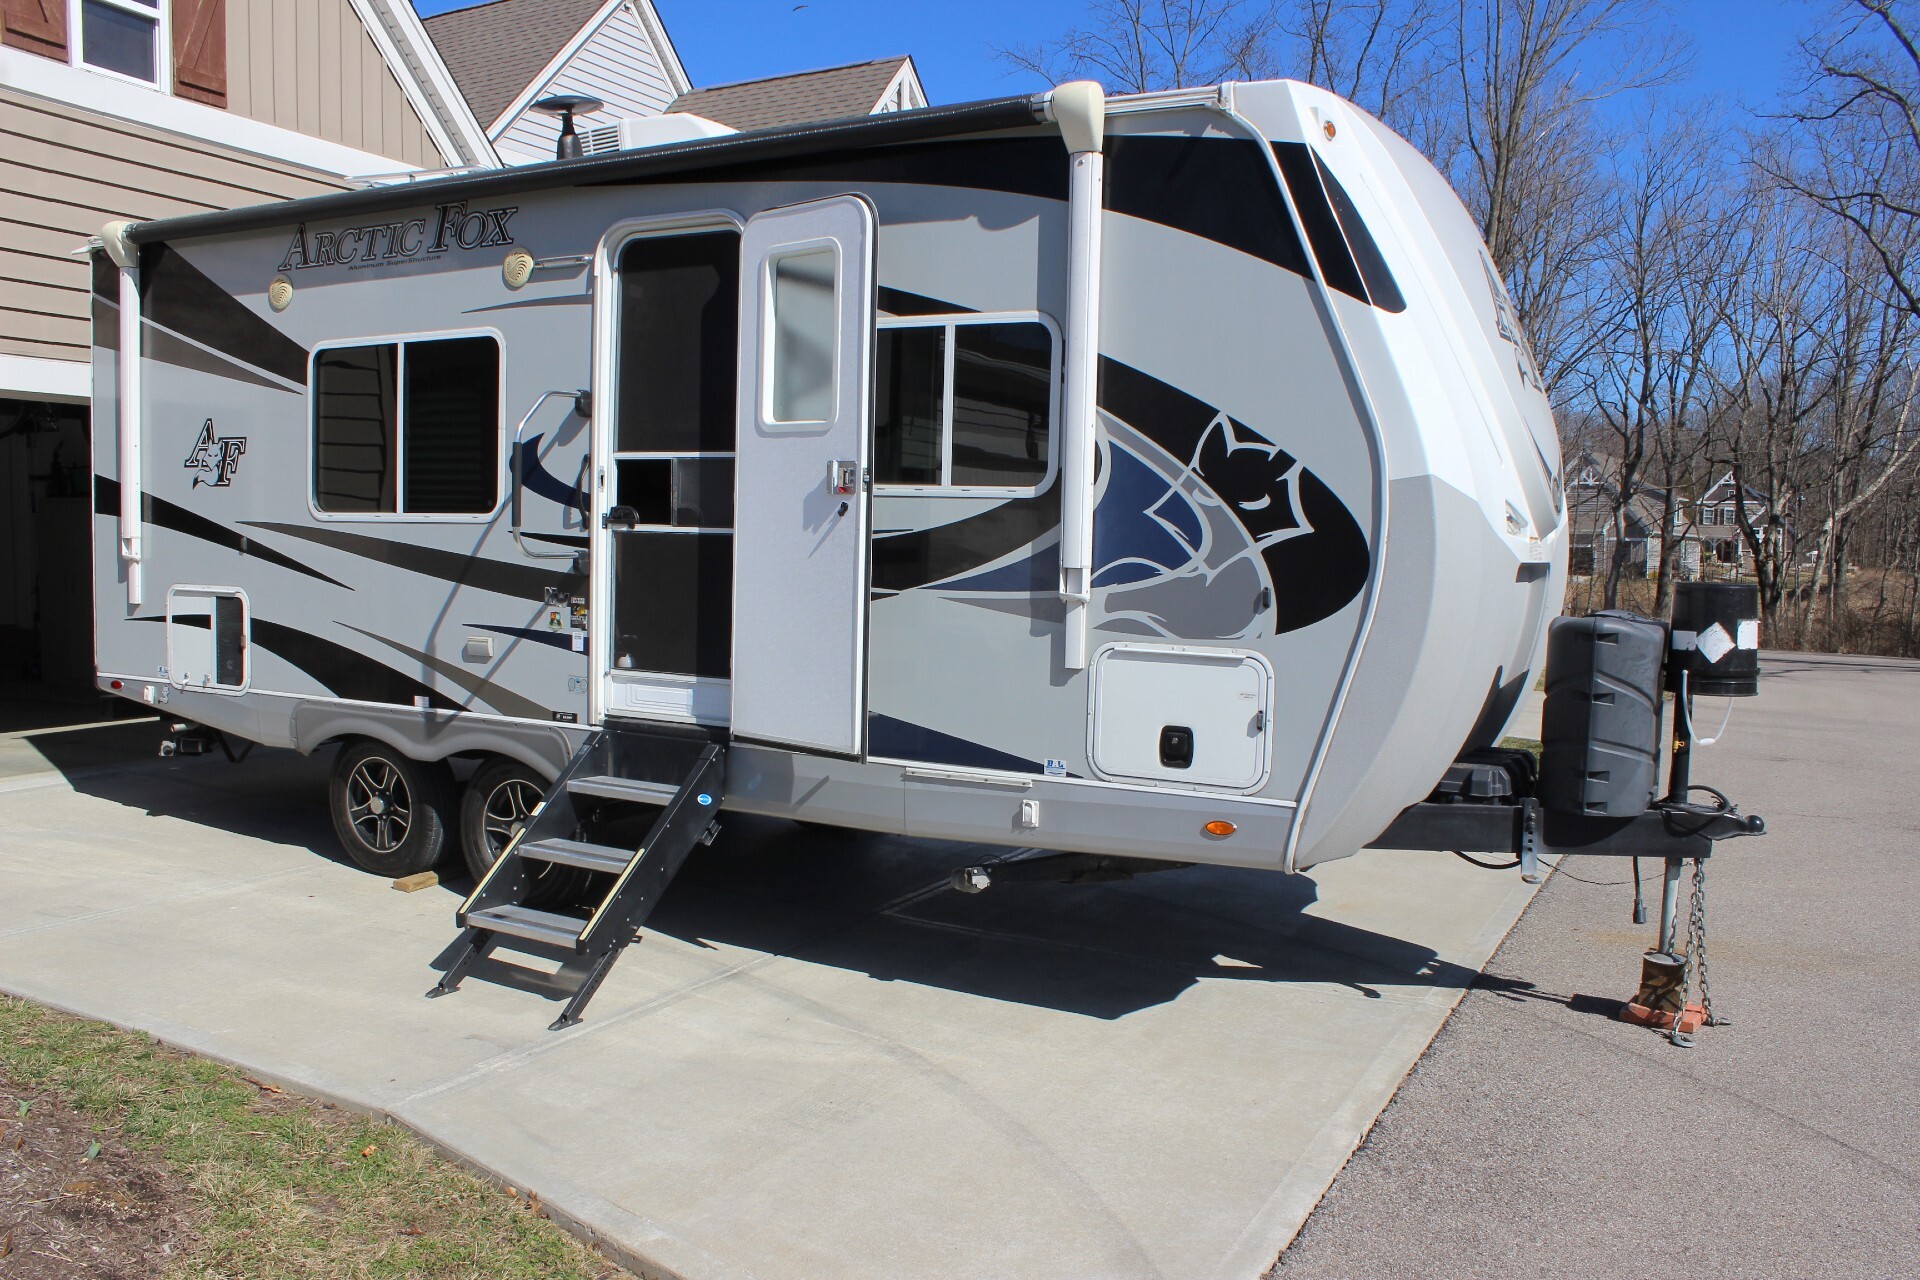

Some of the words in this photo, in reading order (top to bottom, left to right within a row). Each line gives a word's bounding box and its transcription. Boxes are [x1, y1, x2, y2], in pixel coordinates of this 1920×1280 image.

[278, 219, 426, 271] ARCTIC
[427, 201, 519, 253] FOX
[348, 262, 384, 271] Aluminum
